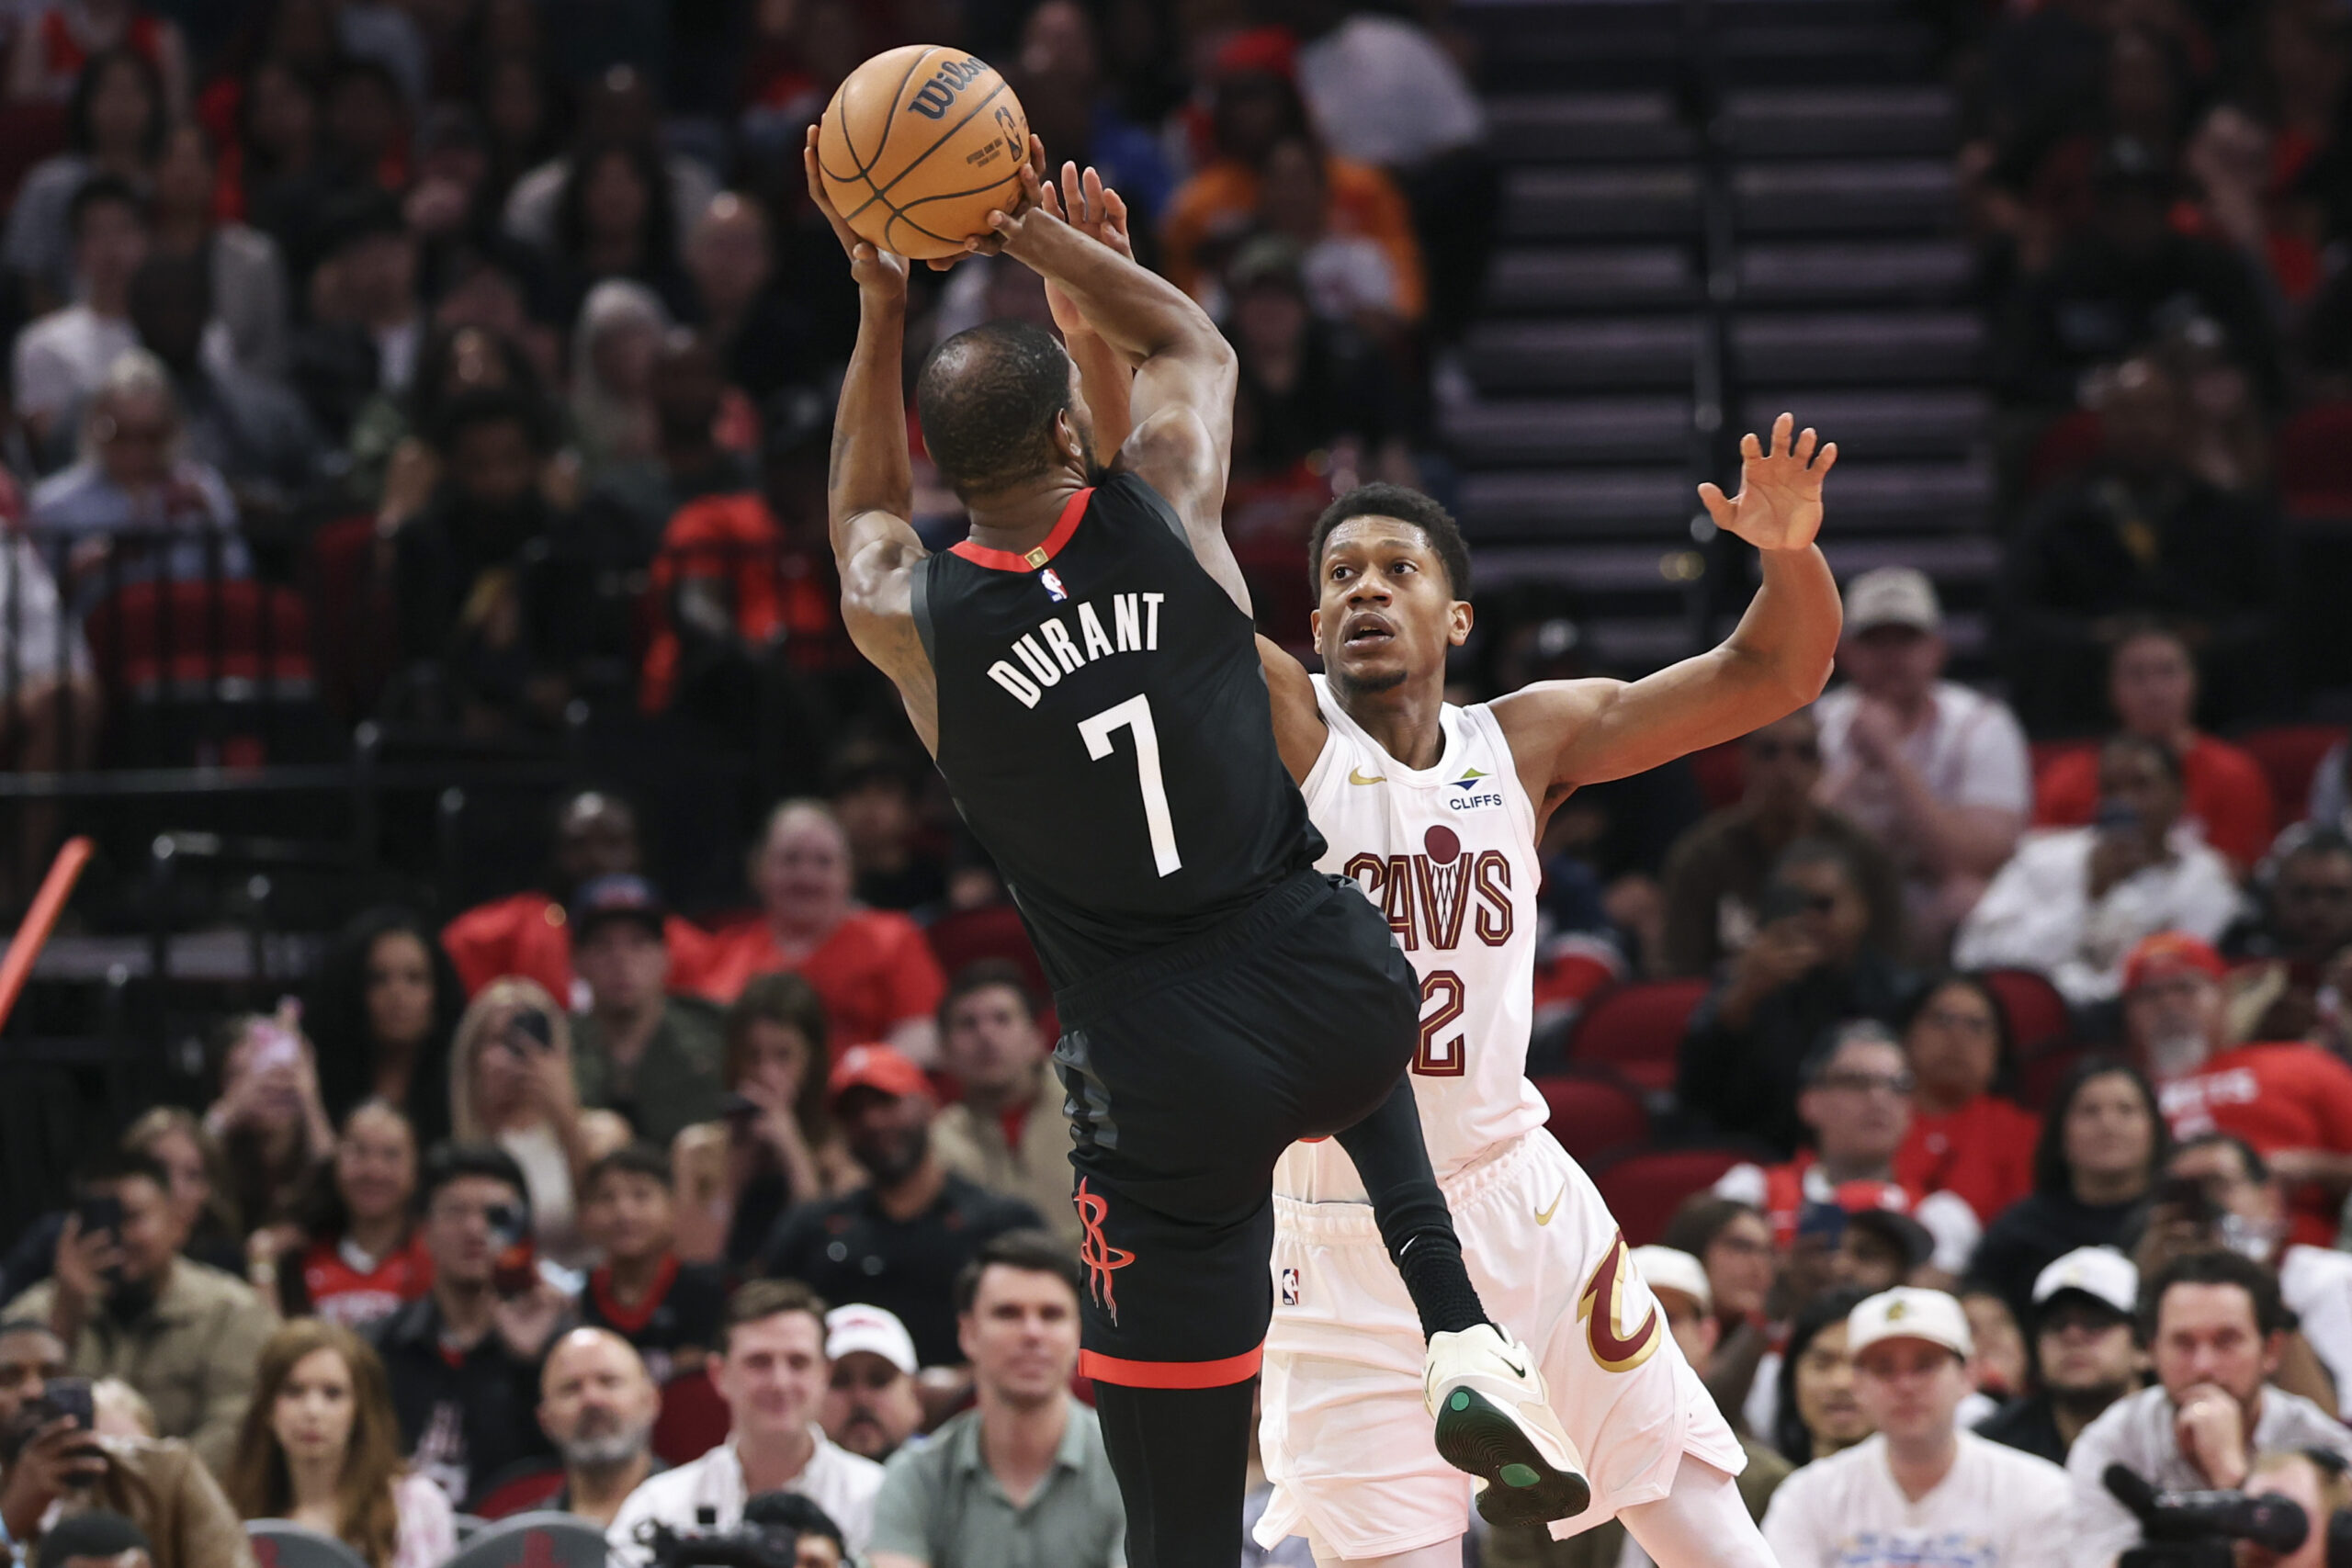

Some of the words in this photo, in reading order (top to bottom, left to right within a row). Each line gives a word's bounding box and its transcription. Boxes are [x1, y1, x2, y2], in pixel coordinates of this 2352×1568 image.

[908, 57, 988, 119] Wilso
[987, 592, 1164, 709] DURANT
[1077, 693, 1182, 878] 7
[1450, 794, 1502, 810] CLIFFS
